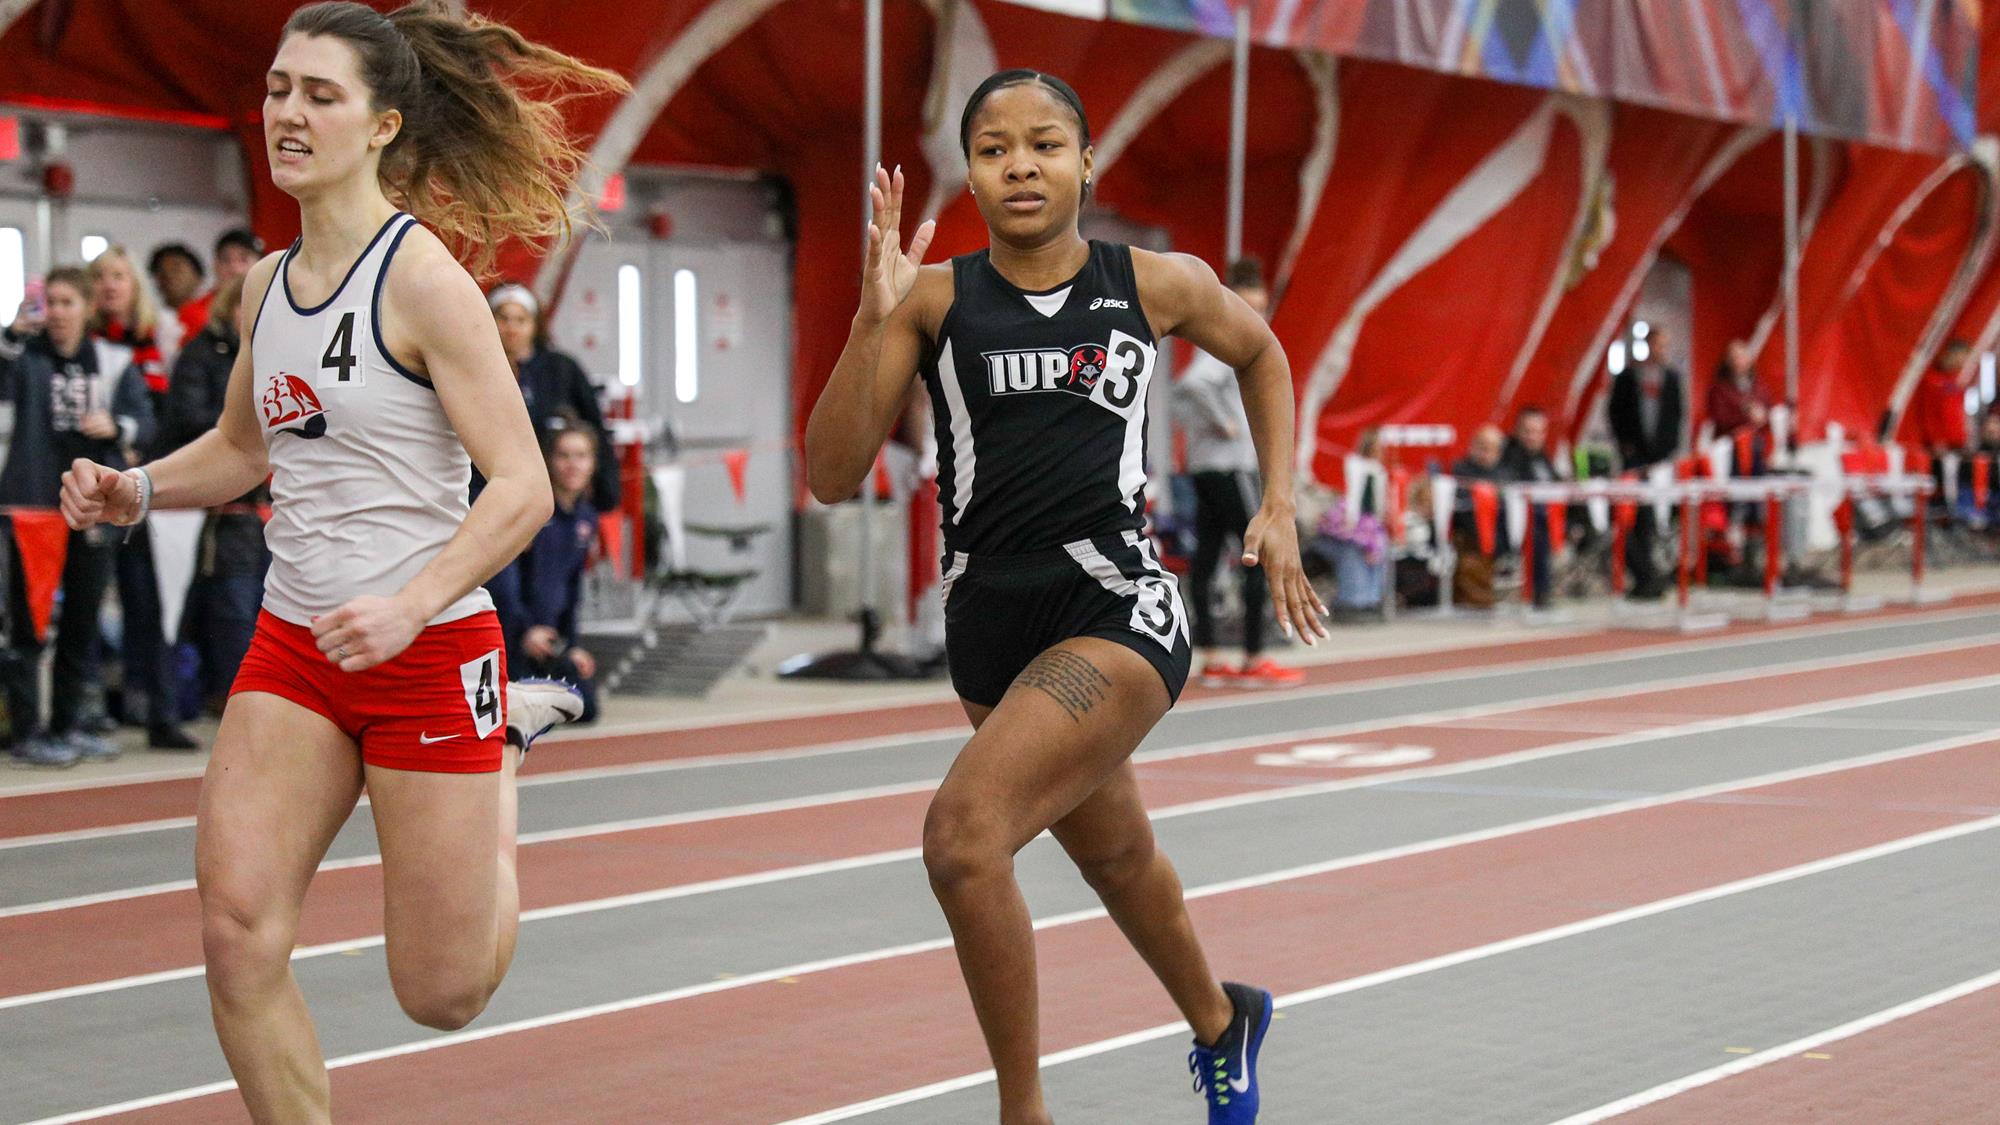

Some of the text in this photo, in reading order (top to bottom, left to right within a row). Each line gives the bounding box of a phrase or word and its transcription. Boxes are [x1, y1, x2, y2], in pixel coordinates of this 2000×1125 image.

[1102, 299, 1129, 309] asics
[321, 312, 356, 381] 4
[988, 350, 1070, 393] IUP
[1103, 340, 1145, 408] 3
[1138, 580, 1174, 637] 3
[475, 658, 498, 726] 4
